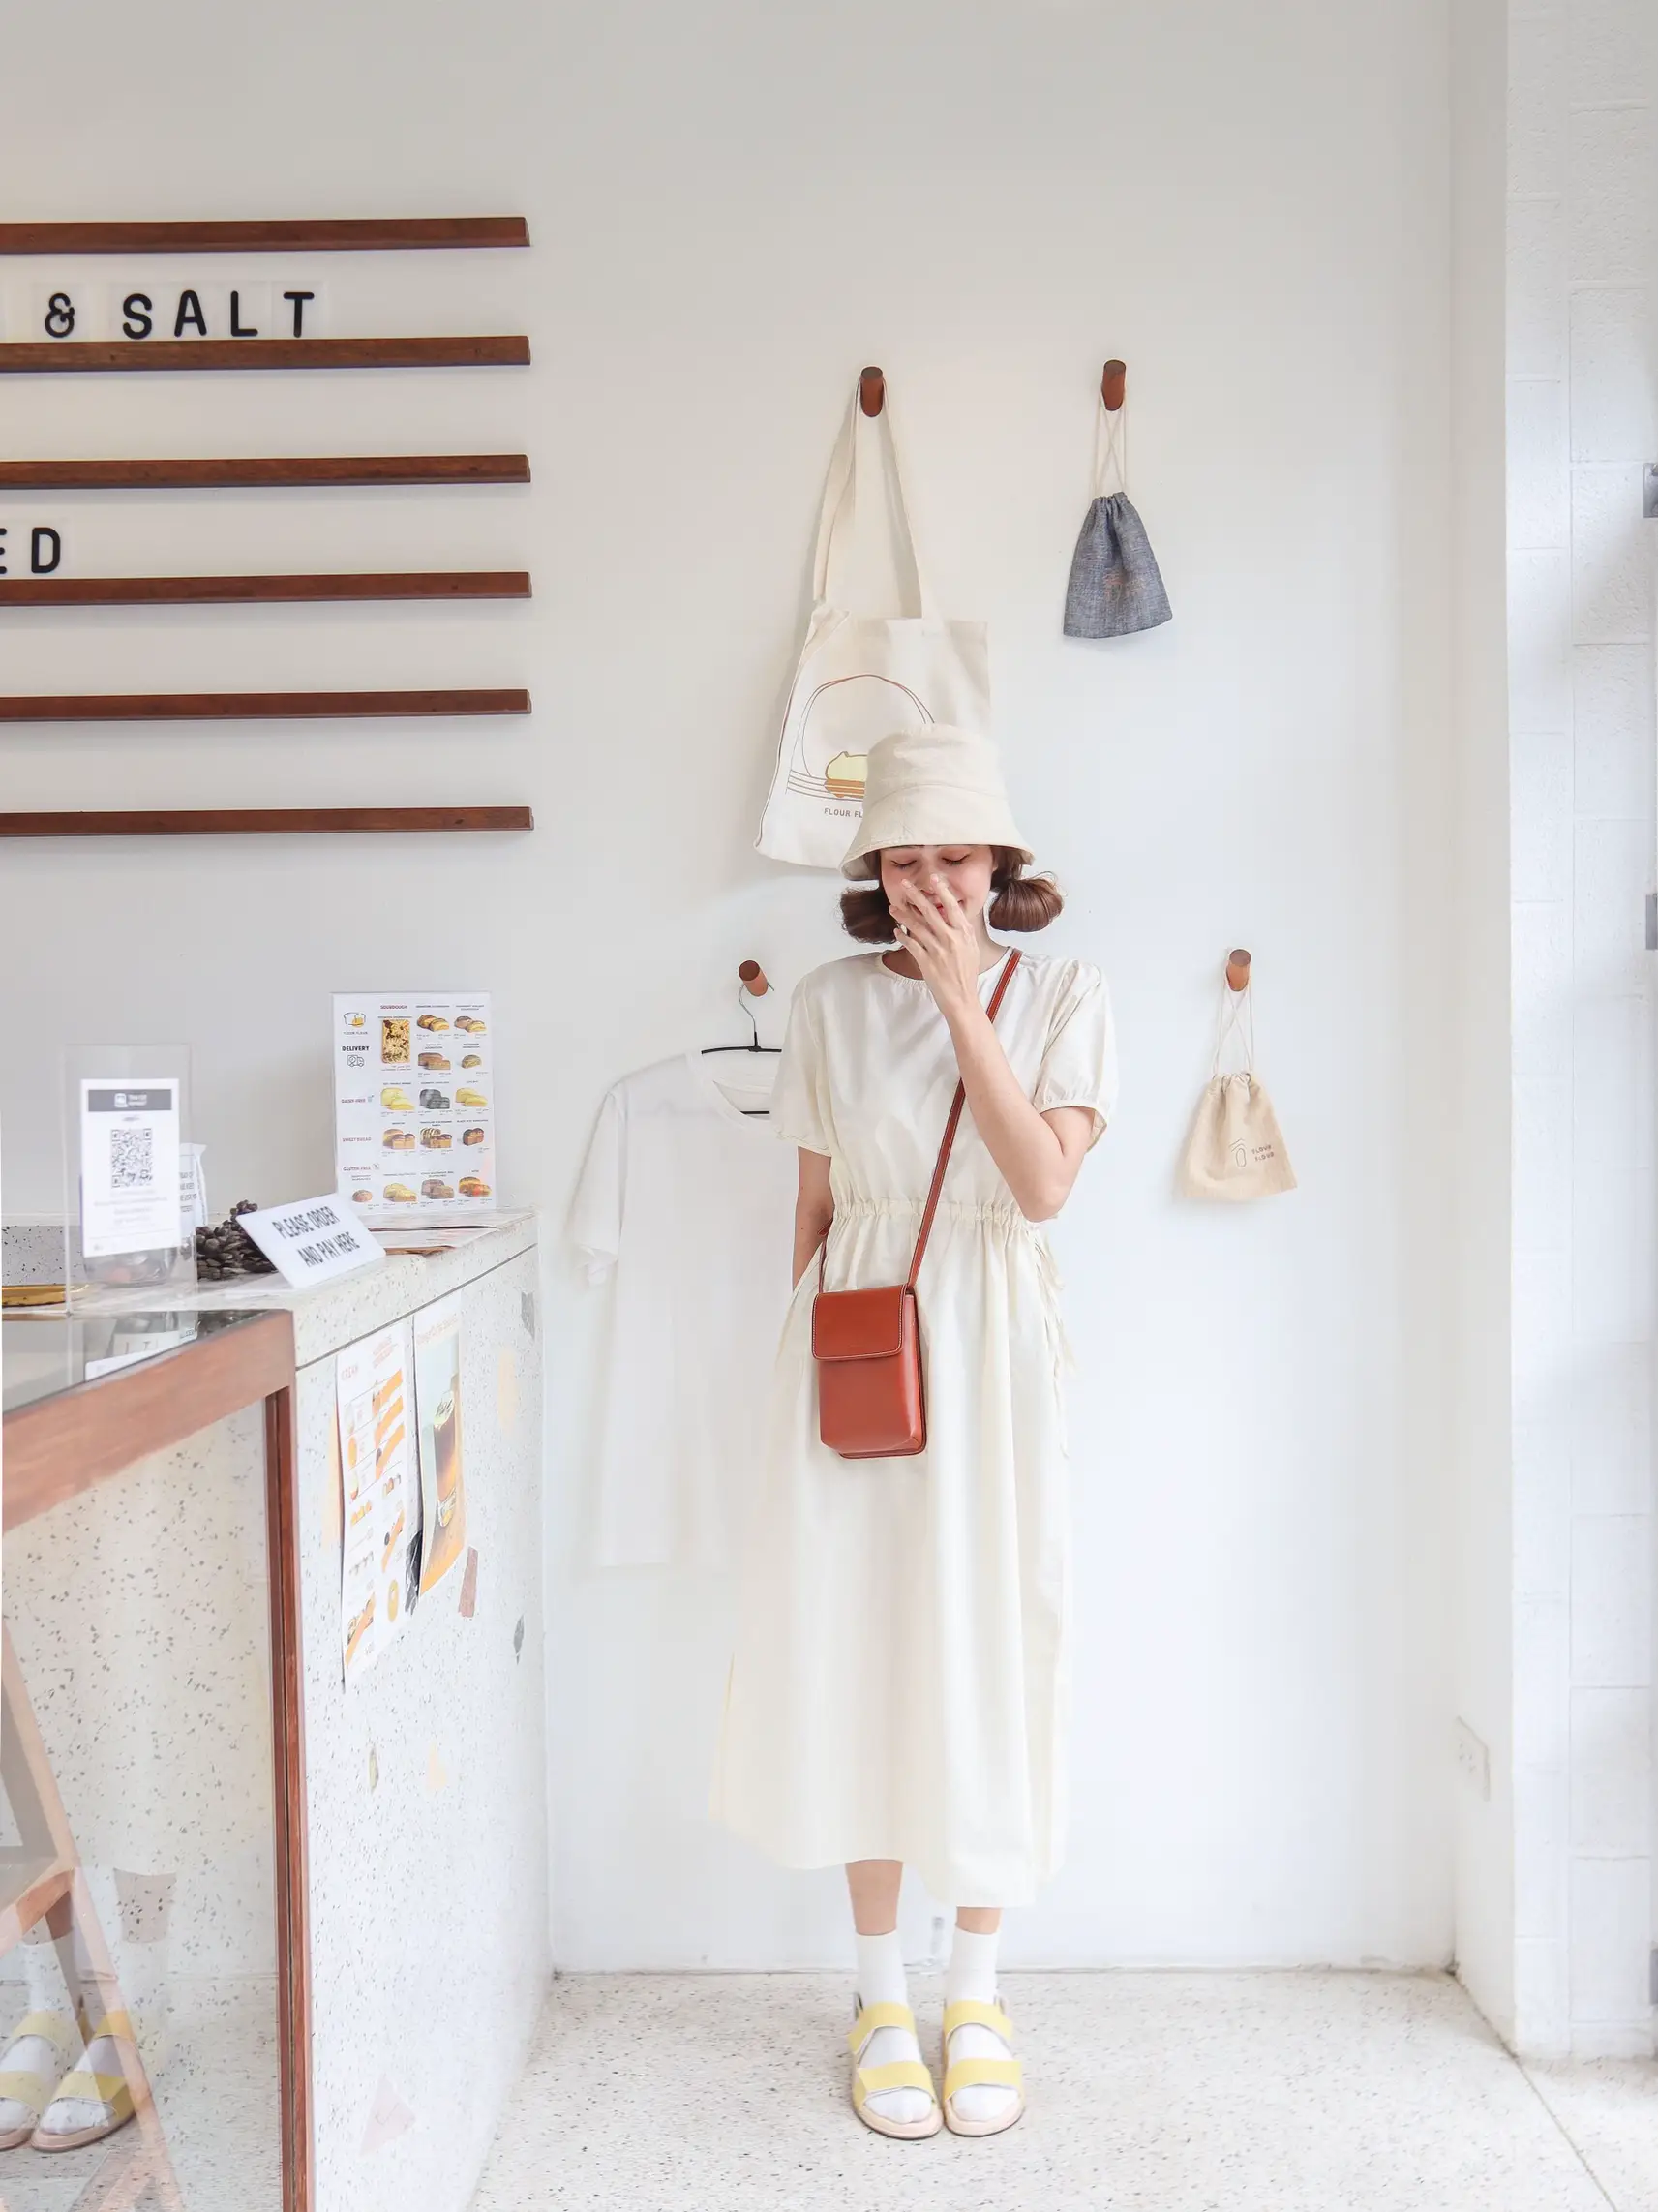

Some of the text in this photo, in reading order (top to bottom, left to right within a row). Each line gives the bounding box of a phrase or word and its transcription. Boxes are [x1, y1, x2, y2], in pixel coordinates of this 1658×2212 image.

[45, 289, 316, 340] & SALT
[824, 807, 851, 818] FLOUR
[272, 1206, 341, 1239] PLEASE ORDER
[297, 1231, 361, 1268] AND PAY HERE
